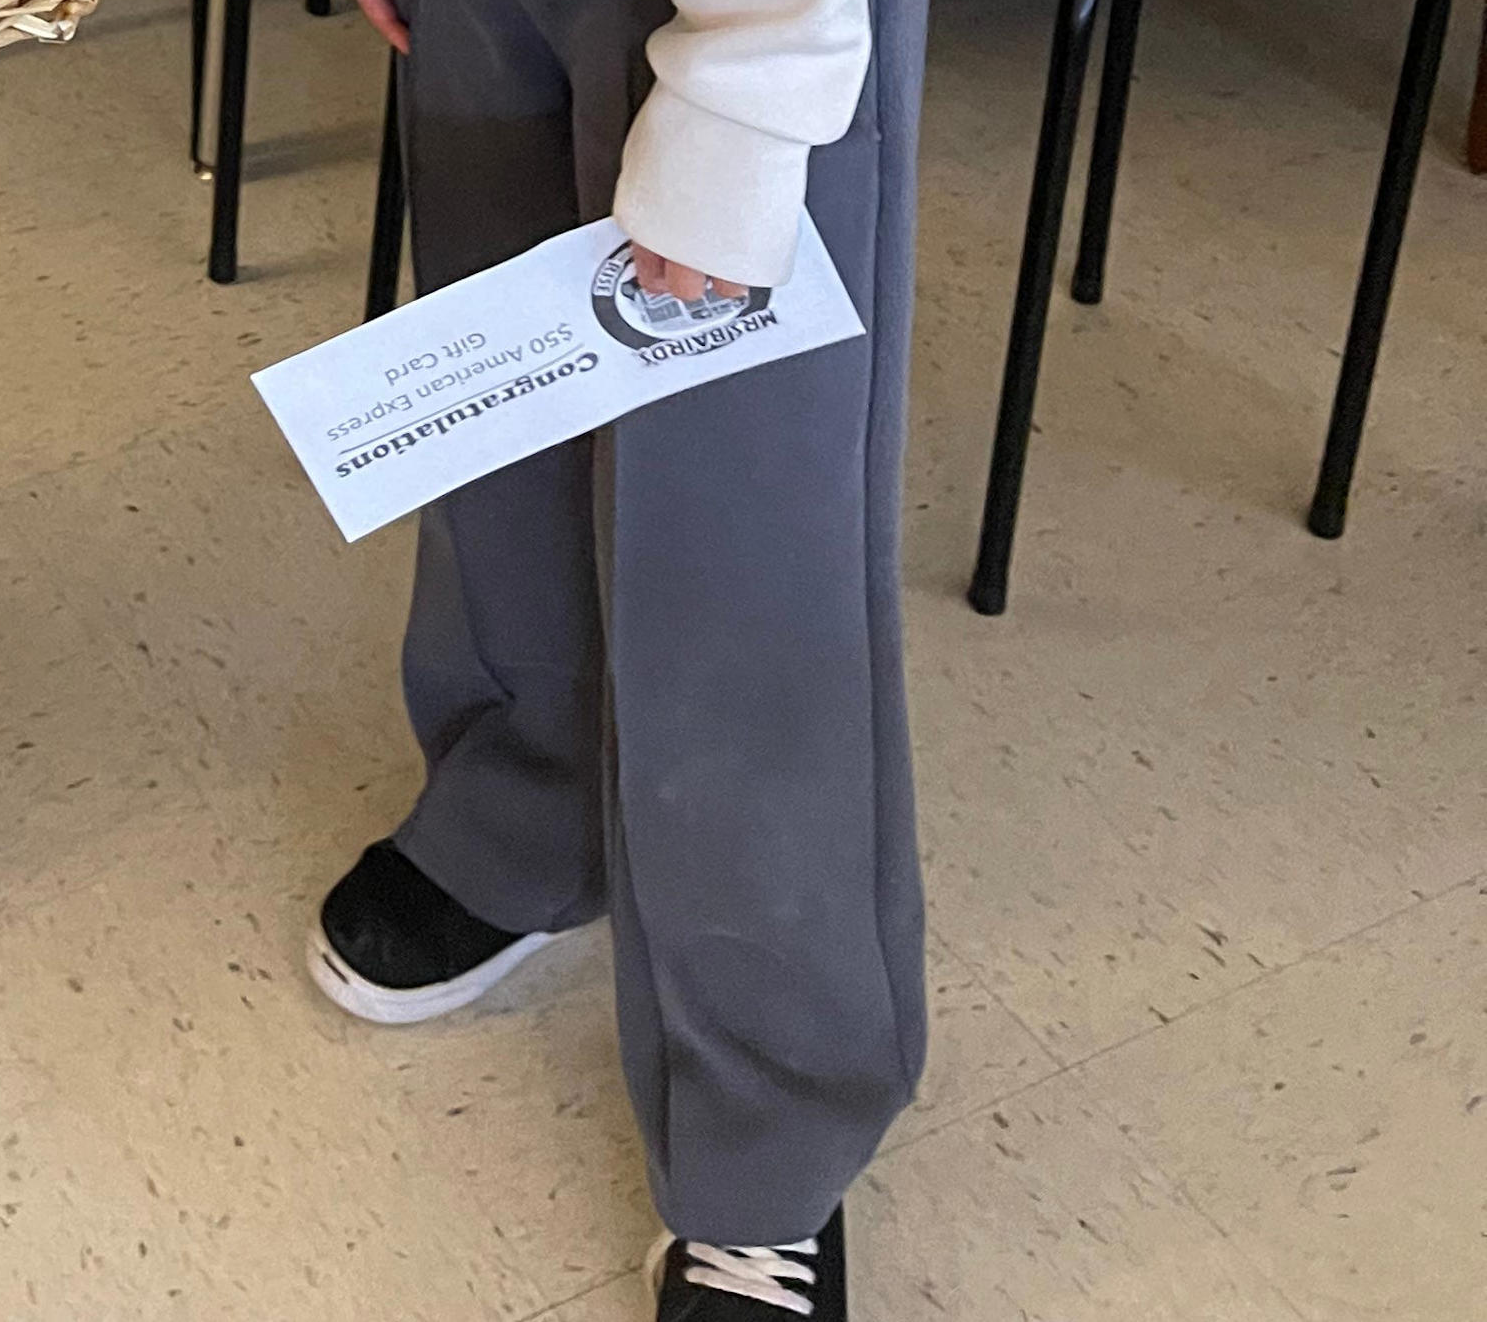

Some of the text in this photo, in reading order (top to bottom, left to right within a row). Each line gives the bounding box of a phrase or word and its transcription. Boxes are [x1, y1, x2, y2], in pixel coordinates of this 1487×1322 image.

[326, 322, 573, 442] $50 American Express
[335, 351, 599, 478] Congratulations
[384, 332, 486, 387] Gift Card
